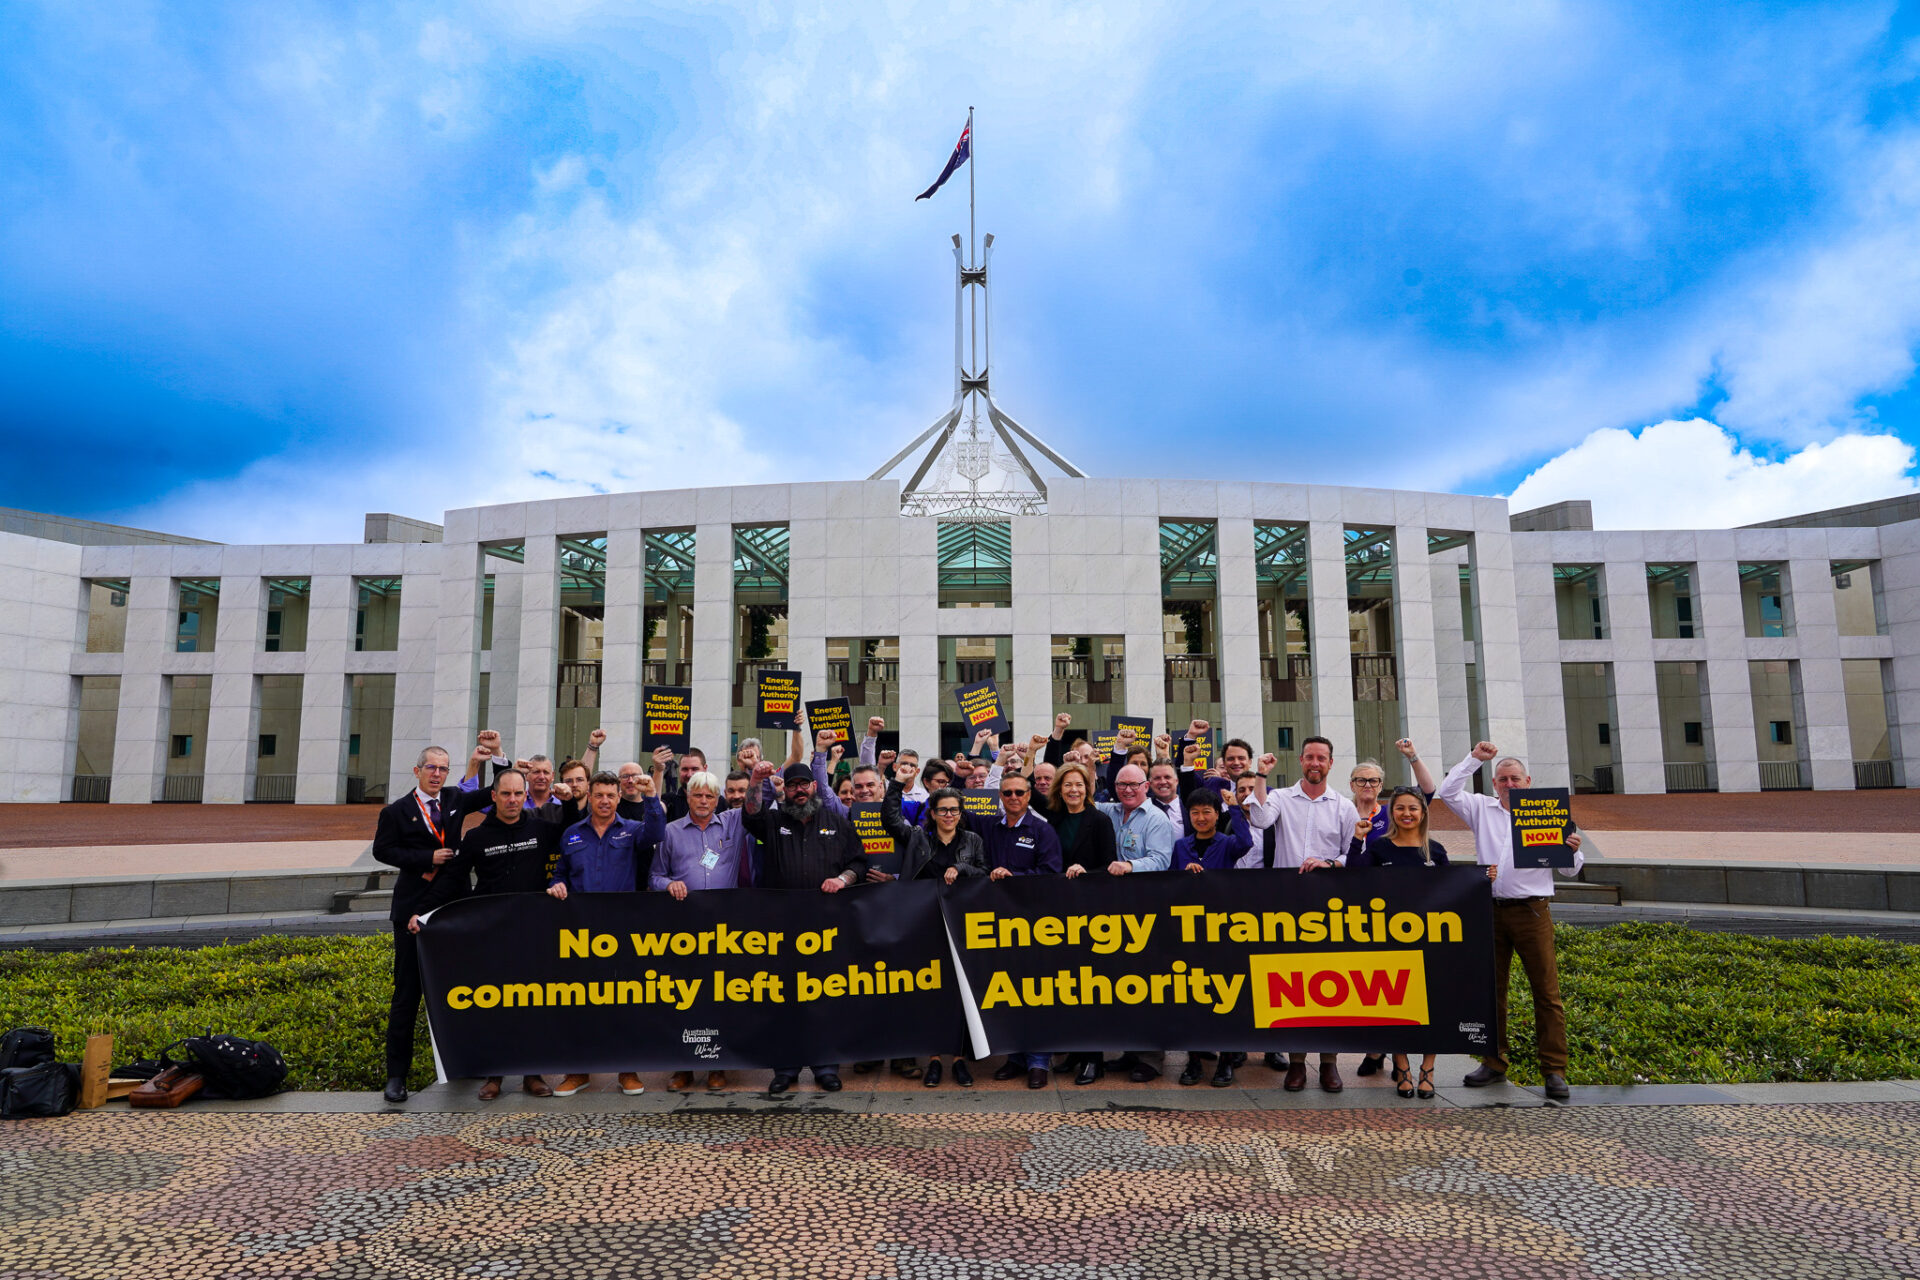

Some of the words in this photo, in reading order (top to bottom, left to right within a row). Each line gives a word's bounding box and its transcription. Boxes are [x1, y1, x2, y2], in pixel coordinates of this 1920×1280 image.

[765, 677, 794, 686] Energy
[760, 684, 799, 692] Transition
[963, 686, 989, 699] Energy
[652, 694, 684, 704] Energy
[760, 691, 798, 700] Authority
[960, 691, 997, 707] Transition
[645, 702, 690, 711] Transition
[814, 706, 843, 715] Energy
[963, 698, 998, 714] Authority
[646, 710, 689, 720] Authority
[810, 712, 850, 722] Transition
[972, 708, 994, 722] NOW
[653, 723, 681, 731] NOW
[812, 719, 850, 730] Authority
[1520, 798, 1559, 808] Energy
[1512, 806, 1568, 816] Transition
[853, 819, 882, 827] Transi
[1515, 816, 1568, 827] Authority
[1525, 832, 1558, 842] NOW
[863, 841, 892, 850] NOW
[965, 911, 1157, 955] Energy
[1171, 897, 1463, 943] Transition
[560, 928, 618, 958] No
[631, 923, 784, 956] worker
[796, 927, 838, 956] or
[447, 969, 702, 1011] community
[714, 970, 786, 1003] left
[797, 959, 942, 1003] behind
[981, 960, 1246, 1015] Authority
[1268, 969, 1411, 1008] NOW
[682, 1028, 719, 1037] Australian
